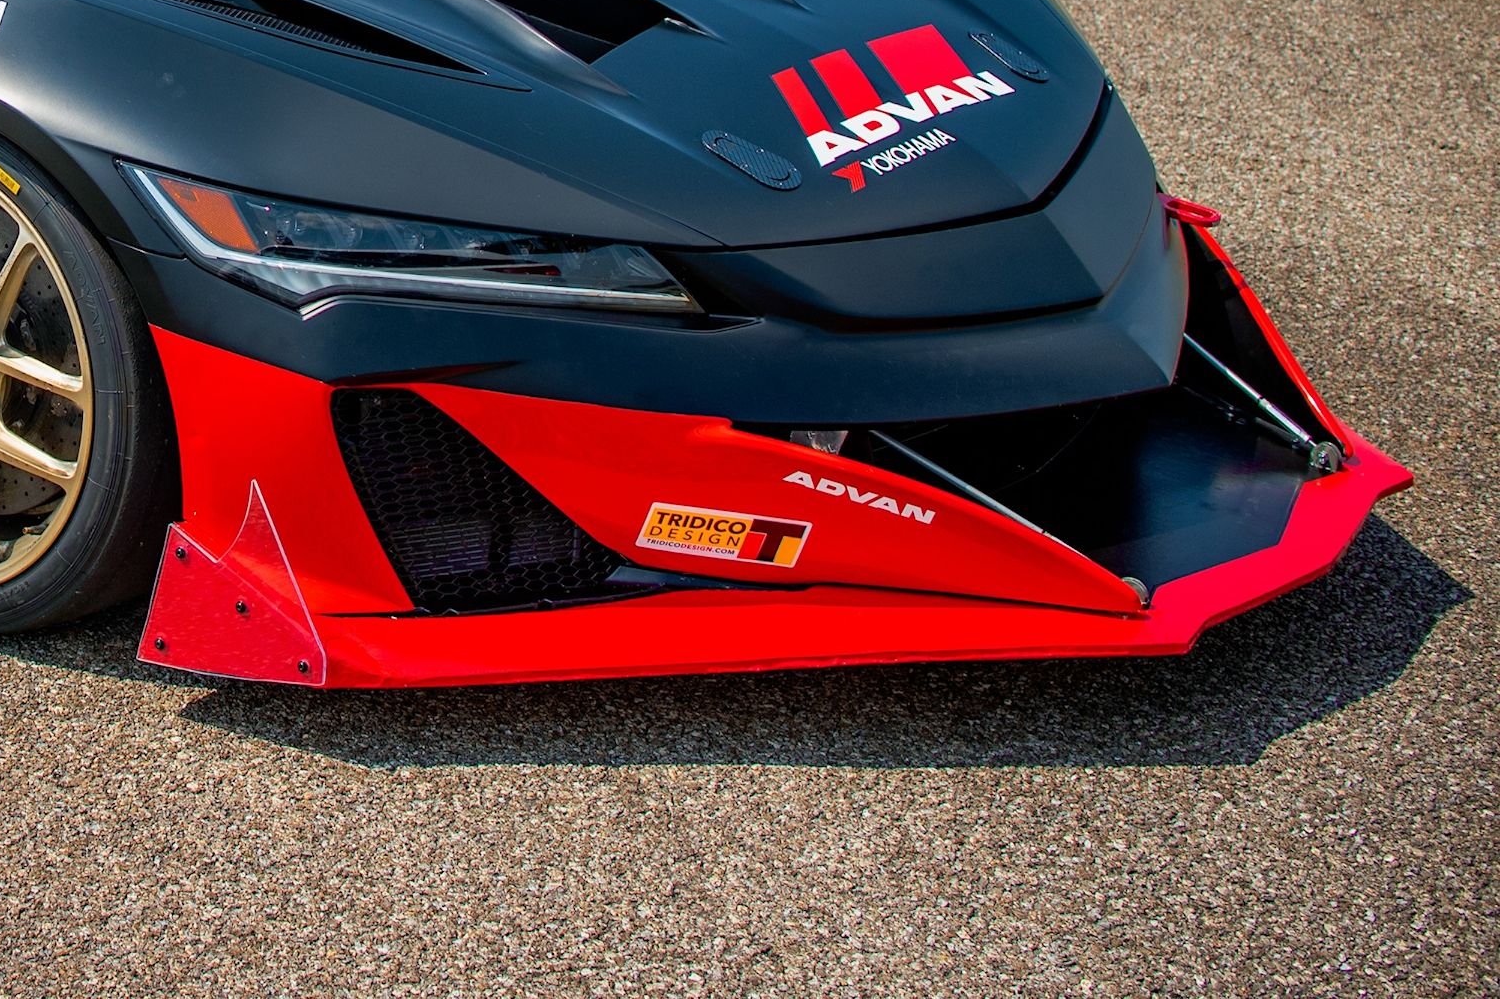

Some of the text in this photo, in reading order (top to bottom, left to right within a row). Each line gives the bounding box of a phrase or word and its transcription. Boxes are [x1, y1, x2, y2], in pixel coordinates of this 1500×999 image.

[807, 71, 1015, 168] ADVAN
[860, 128, 956, 175] YOKOHAMA
[782, 471, 936, 524] ADVAN
[650, 526, 741, 547] DESIGN
[657, 511, 747, 535] TRIDICO
[646, 538, 735, 556] TRIDICODESIGN.COM
